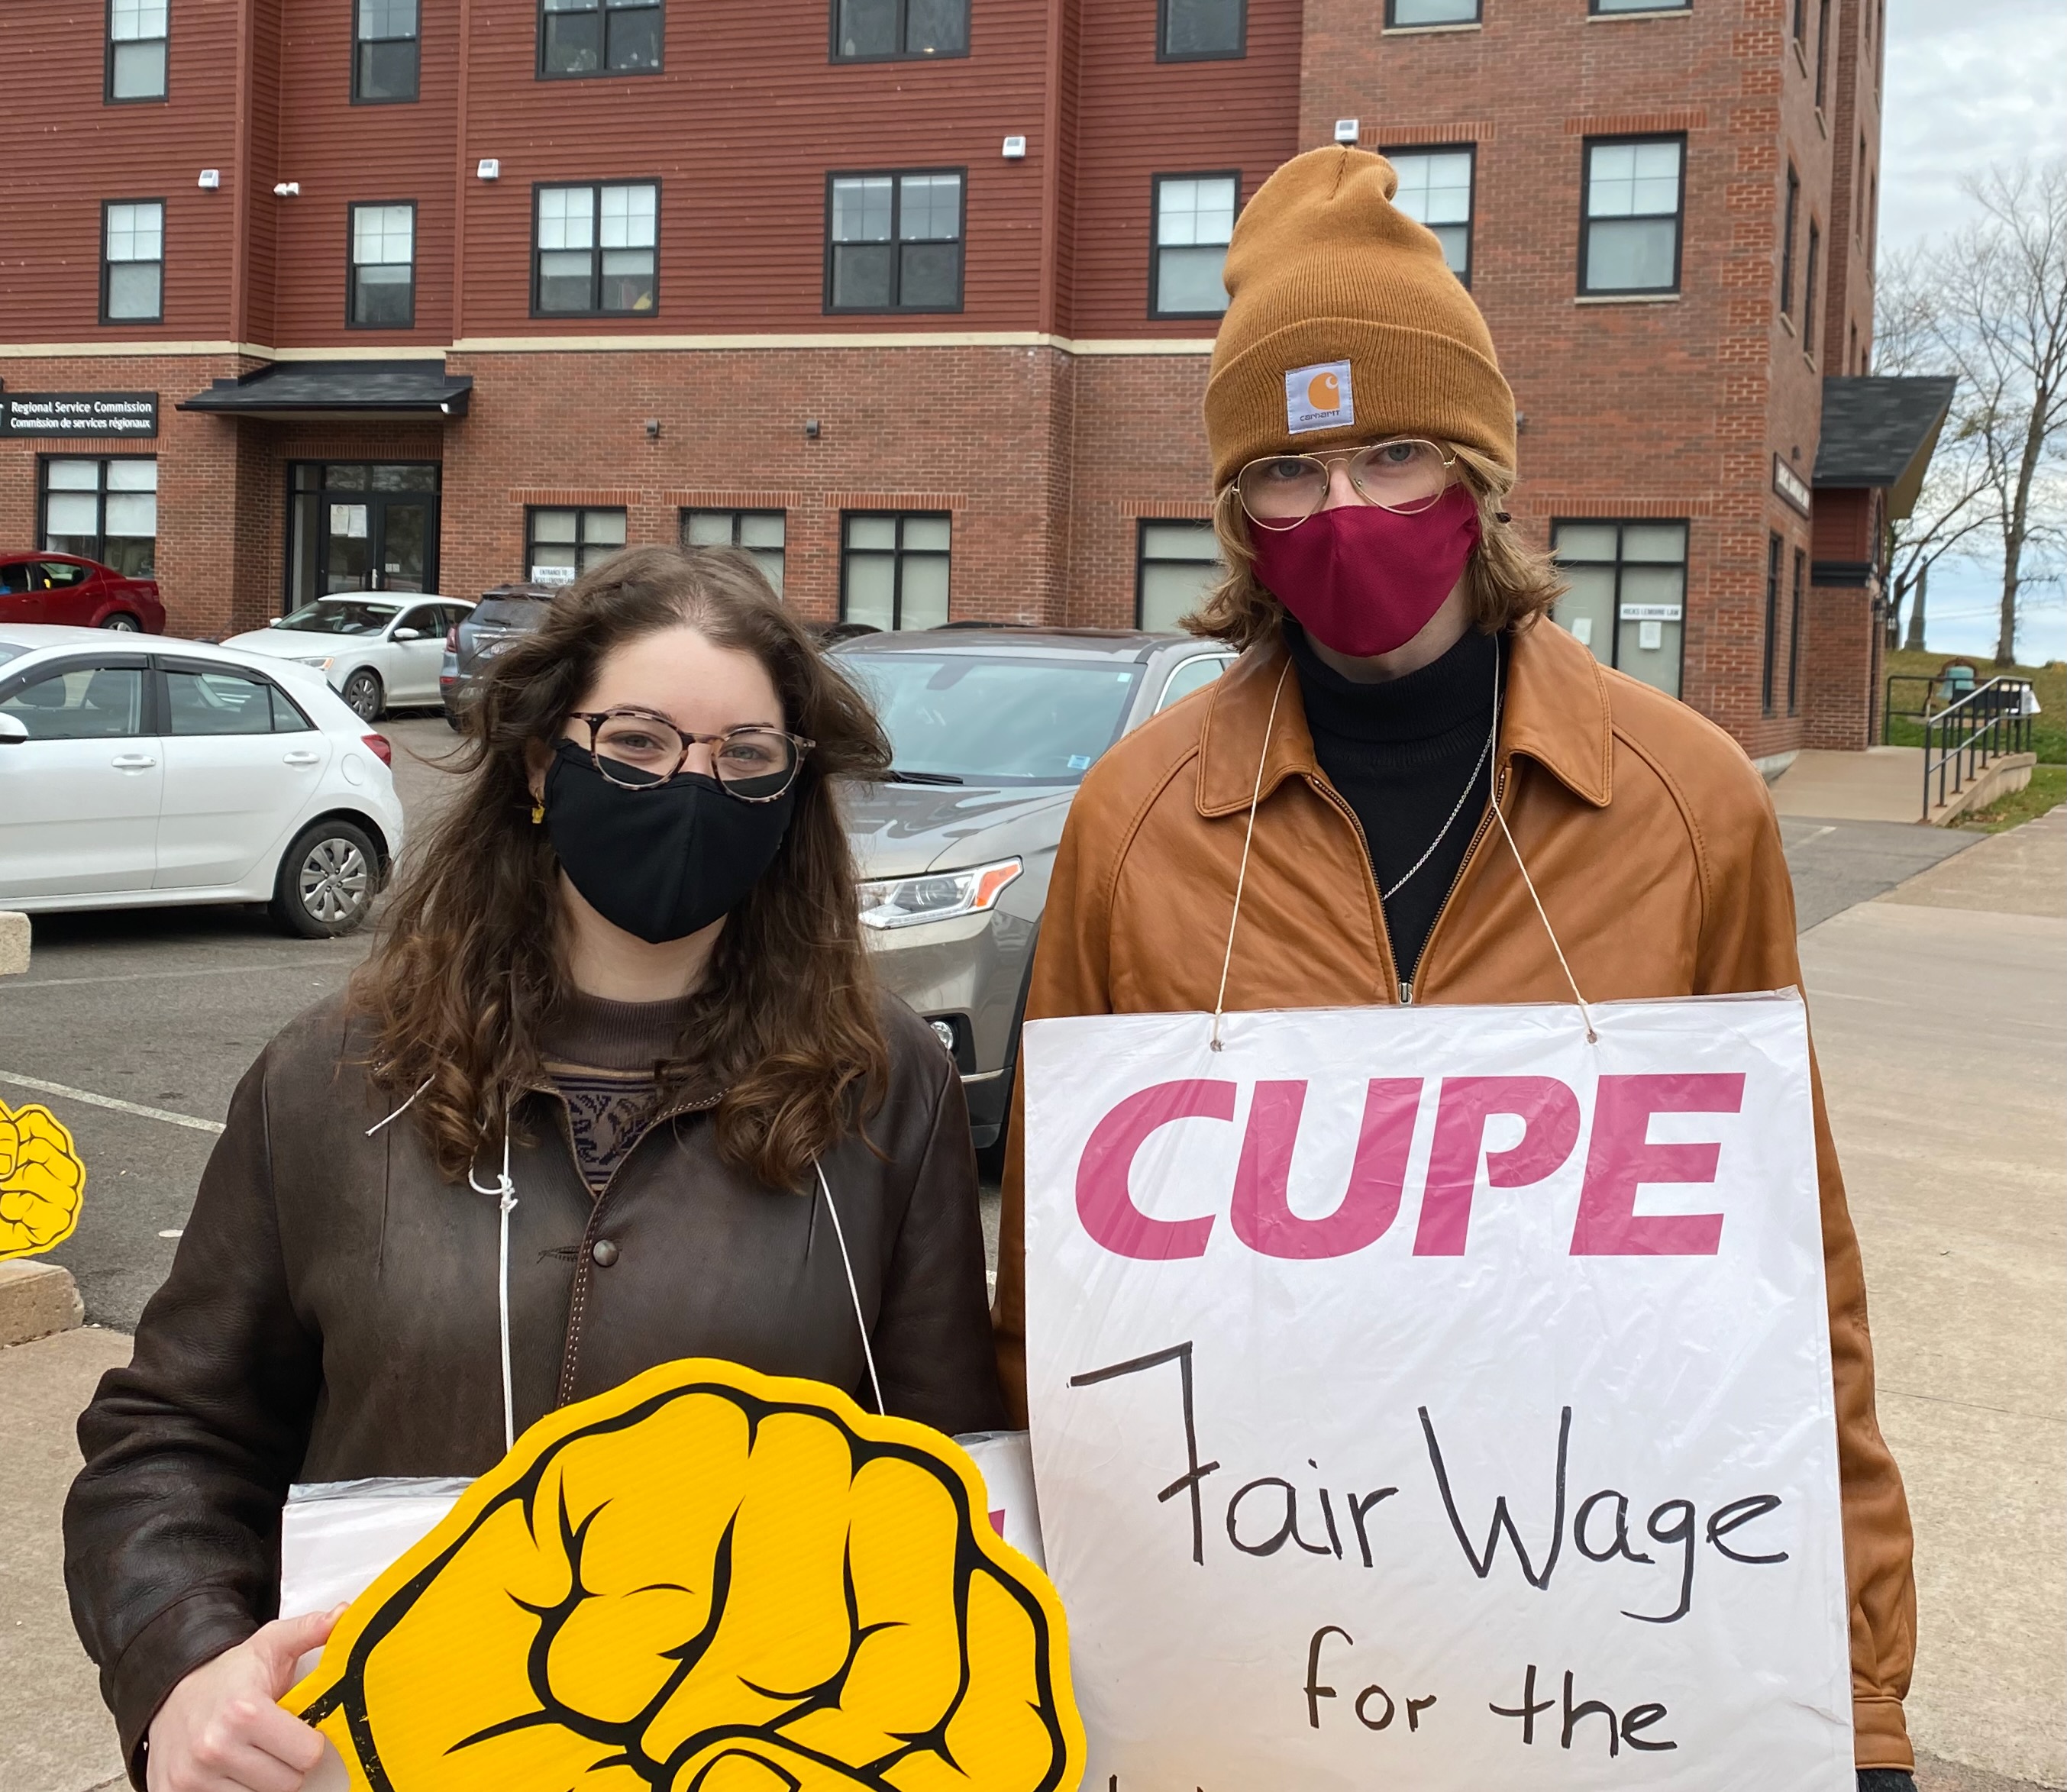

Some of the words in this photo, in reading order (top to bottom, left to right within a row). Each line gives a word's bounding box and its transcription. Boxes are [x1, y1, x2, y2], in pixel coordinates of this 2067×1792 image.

[10, 418, 59, 428] Commission
[60, 418, 72, 428] de
[73, 418, 107, 428] services
[109, 417, 151, 431] régionaux
[11, 402, 53, 415] Regional
[54, 402, 91, 413] Service
[94, 401, 153, 413] Commission
[1300, 410, 1340, 421] carhartt
[1076, 1073, 1745, 1260] CUPE
[1069, 1341, 1399, 1568] Fair
[1419, 1406, 1789, 1623] Wage
[1303, 1626, 1437, 1732] for
[1489, 1664, 1678, 1758] the
